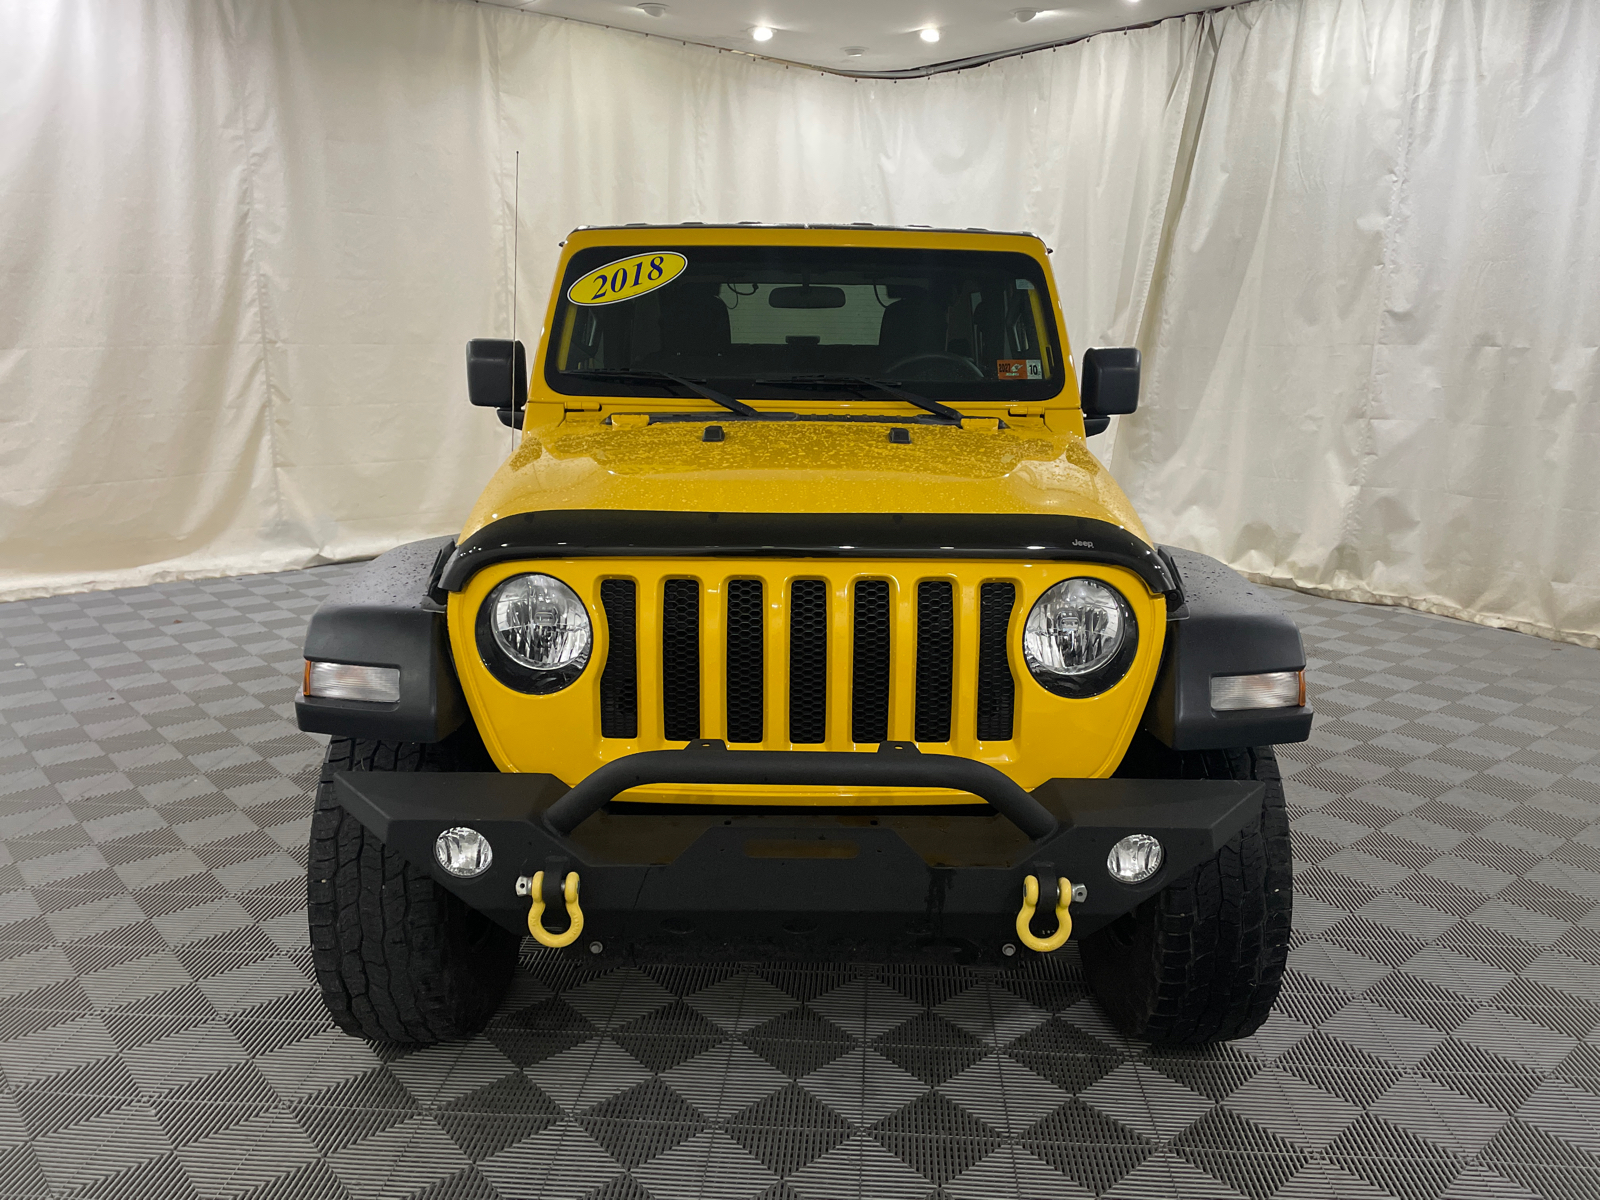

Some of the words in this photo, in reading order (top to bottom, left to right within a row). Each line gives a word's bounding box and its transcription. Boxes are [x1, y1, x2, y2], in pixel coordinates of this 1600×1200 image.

[591, 256, 664, 301] 2018
[1029, 364, 1038, 375] 10
[1071, 538, 1094, 549] Jeep
